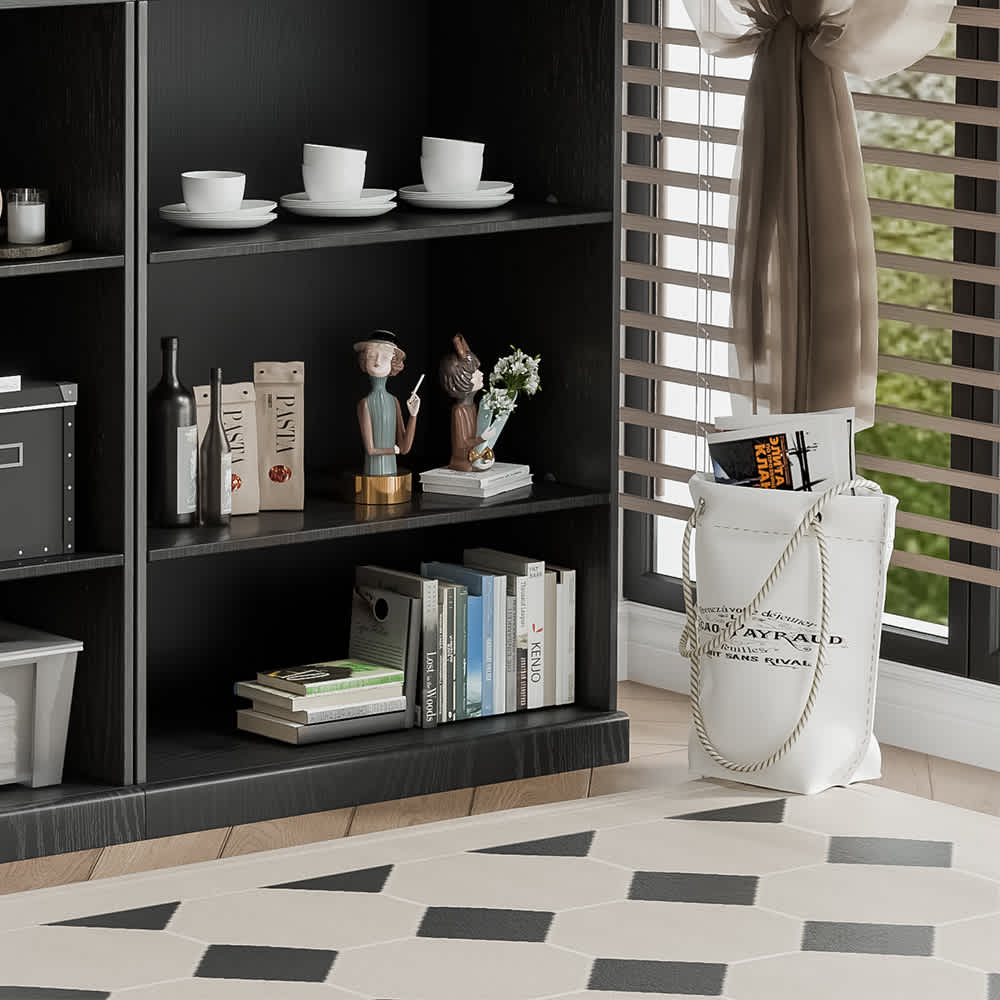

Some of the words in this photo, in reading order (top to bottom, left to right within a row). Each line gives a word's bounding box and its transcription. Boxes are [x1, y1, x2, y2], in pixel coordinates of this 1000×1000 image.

[276, 393, 296, 455] PASTA
[769, 436, 784, 486] ЭЛИТА
[426, 651, 437, 673] Lost
[530, 642, 542, 683] KENJO
[725, 653, 759, 662] SANS
[764, 657, 812, 670] RIVAL
[426, 688, 438, 722] Woods
